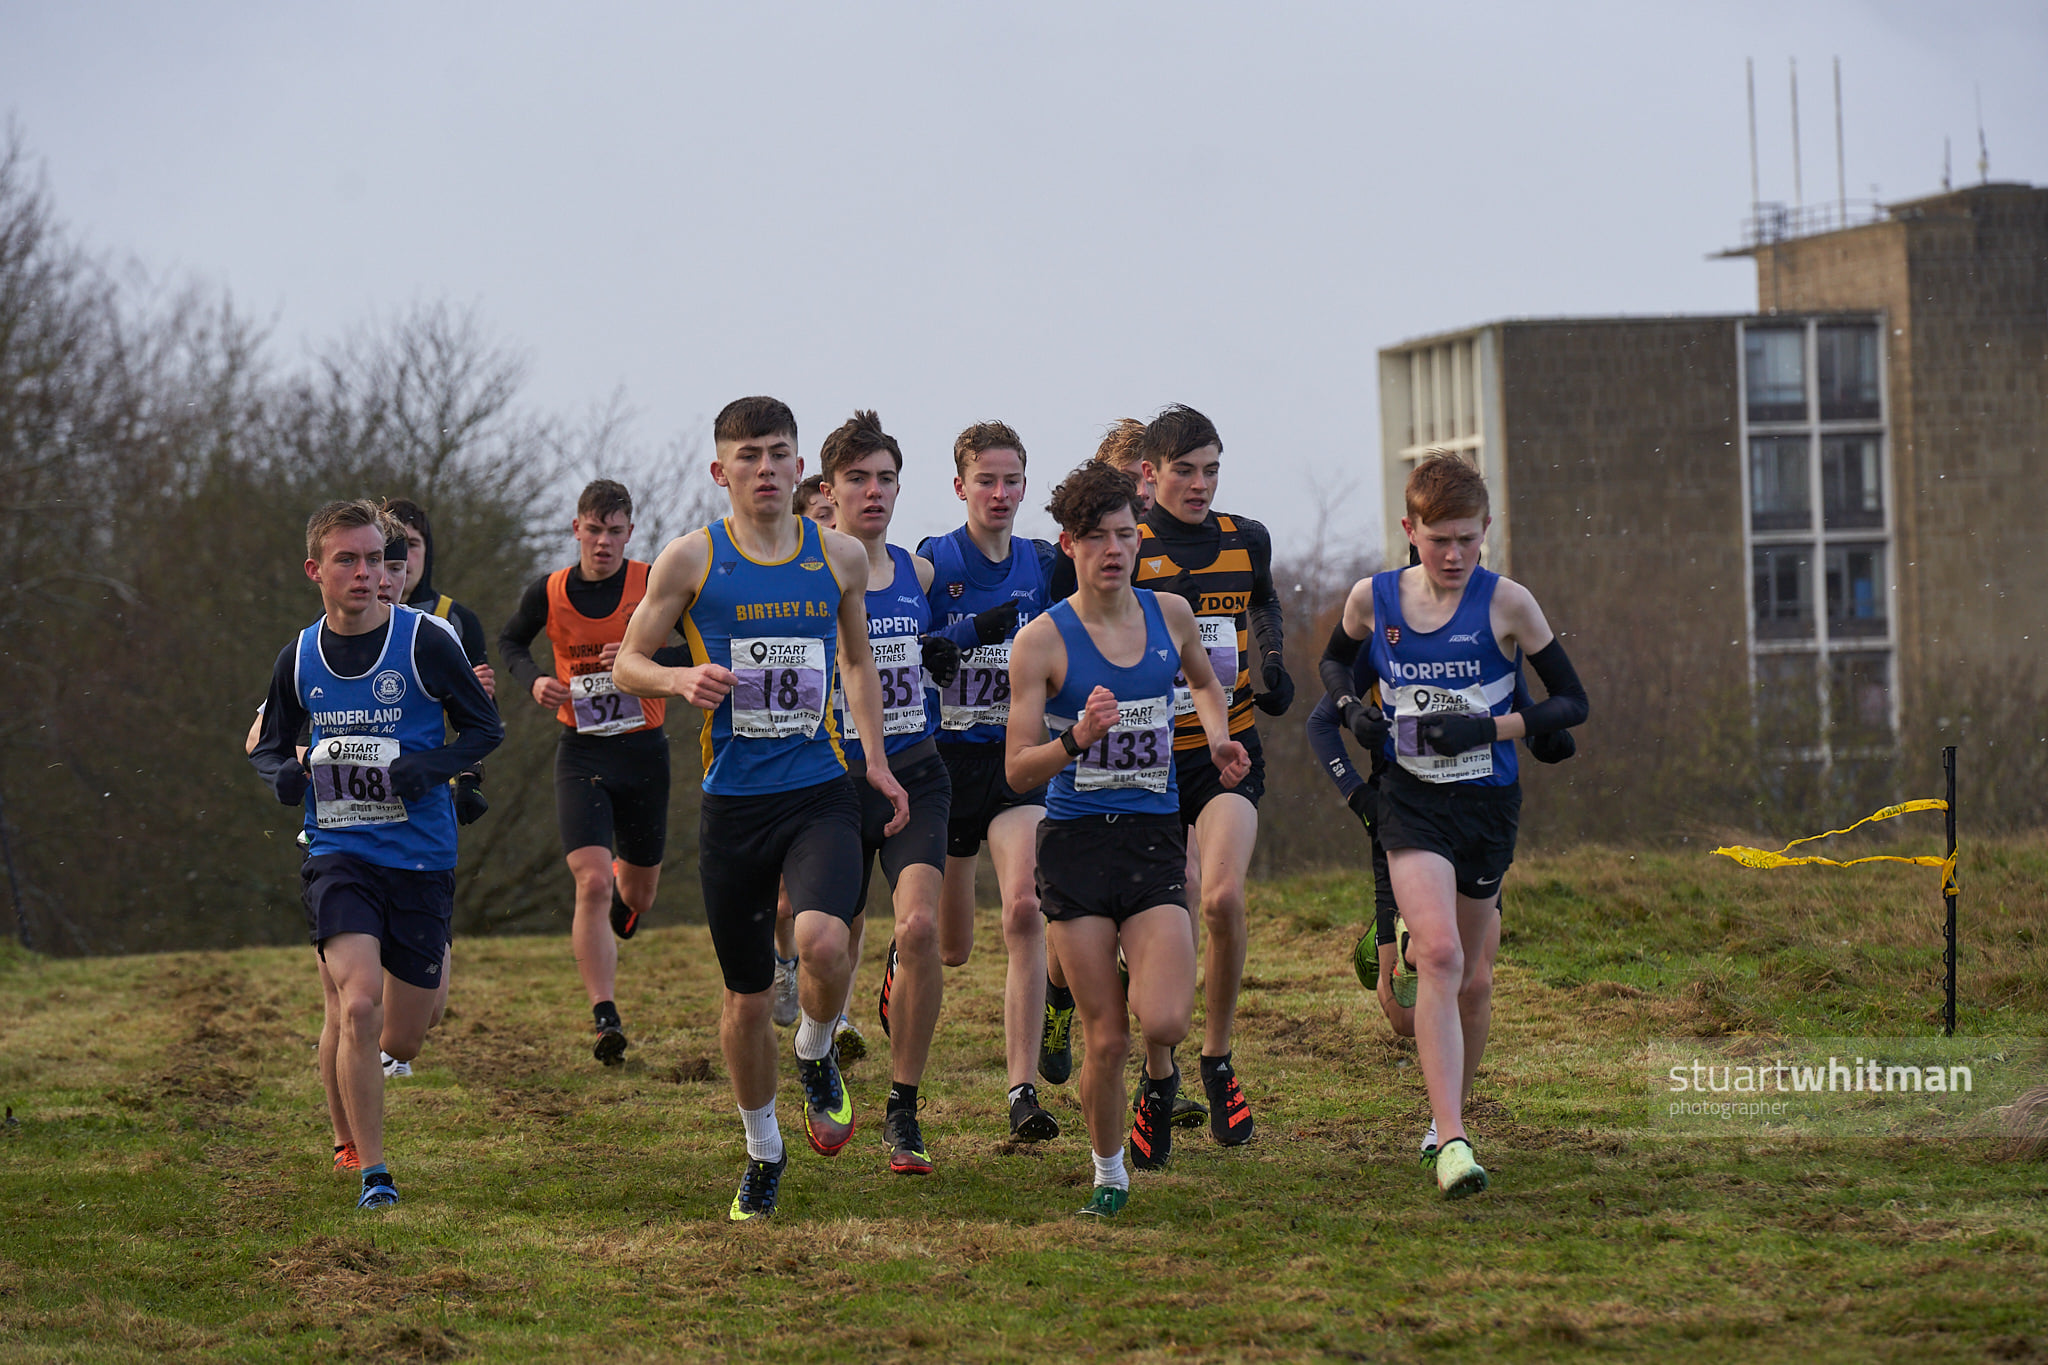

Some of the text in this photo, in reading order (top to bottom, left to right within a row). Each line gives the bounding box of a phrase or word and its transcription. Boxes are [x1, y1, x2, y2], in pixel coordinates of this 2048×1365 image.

[1199, 596, 1245, 610] YDON
[736, 601, 831, 621] BIRTLEY A.C.
[867, 616, 919, 635] RPETH
[1199, 623, 1220, 633] ART
[568, 643, 604, 658] DURHA
[769, 645, 807, 655] START
[875, 643, 906, 655] START
[975, 647, 1009, 657] START
[768, 655, 806, 664] FITNESS
[874, 653, 906, 663] FITNESS
[974, 656, 1008, 664] FITNESS
[1389, 660, 1480, 680] MORPETH
[594, 677, 614, 686] STA
[960, 669, 1010, 705] 128
[763, 668, 799, 710] 18
[879, 667, 912, 709] 35
[1432, 693, 1468, 704] STAR
[591, 693, 624, 724] 52
[1431, 703, 1470, 712] FITNESS
[313, 707, 403, 726] SUNDERLAND
[793, 711, 820, 722] U17/20
[322, 723, 396, 735] HARRIERS & AC
[884, 724, 909, 732] League
[343, 743, 381, 753] START
[1099, 731, 1158, 769] 133
[342, 753, 379, 761] FITNESS
[1462, 753, 1491, 763] U17/20
[331, 765, 386, 801] 168
[330, 814, 357, 823] Harrier
